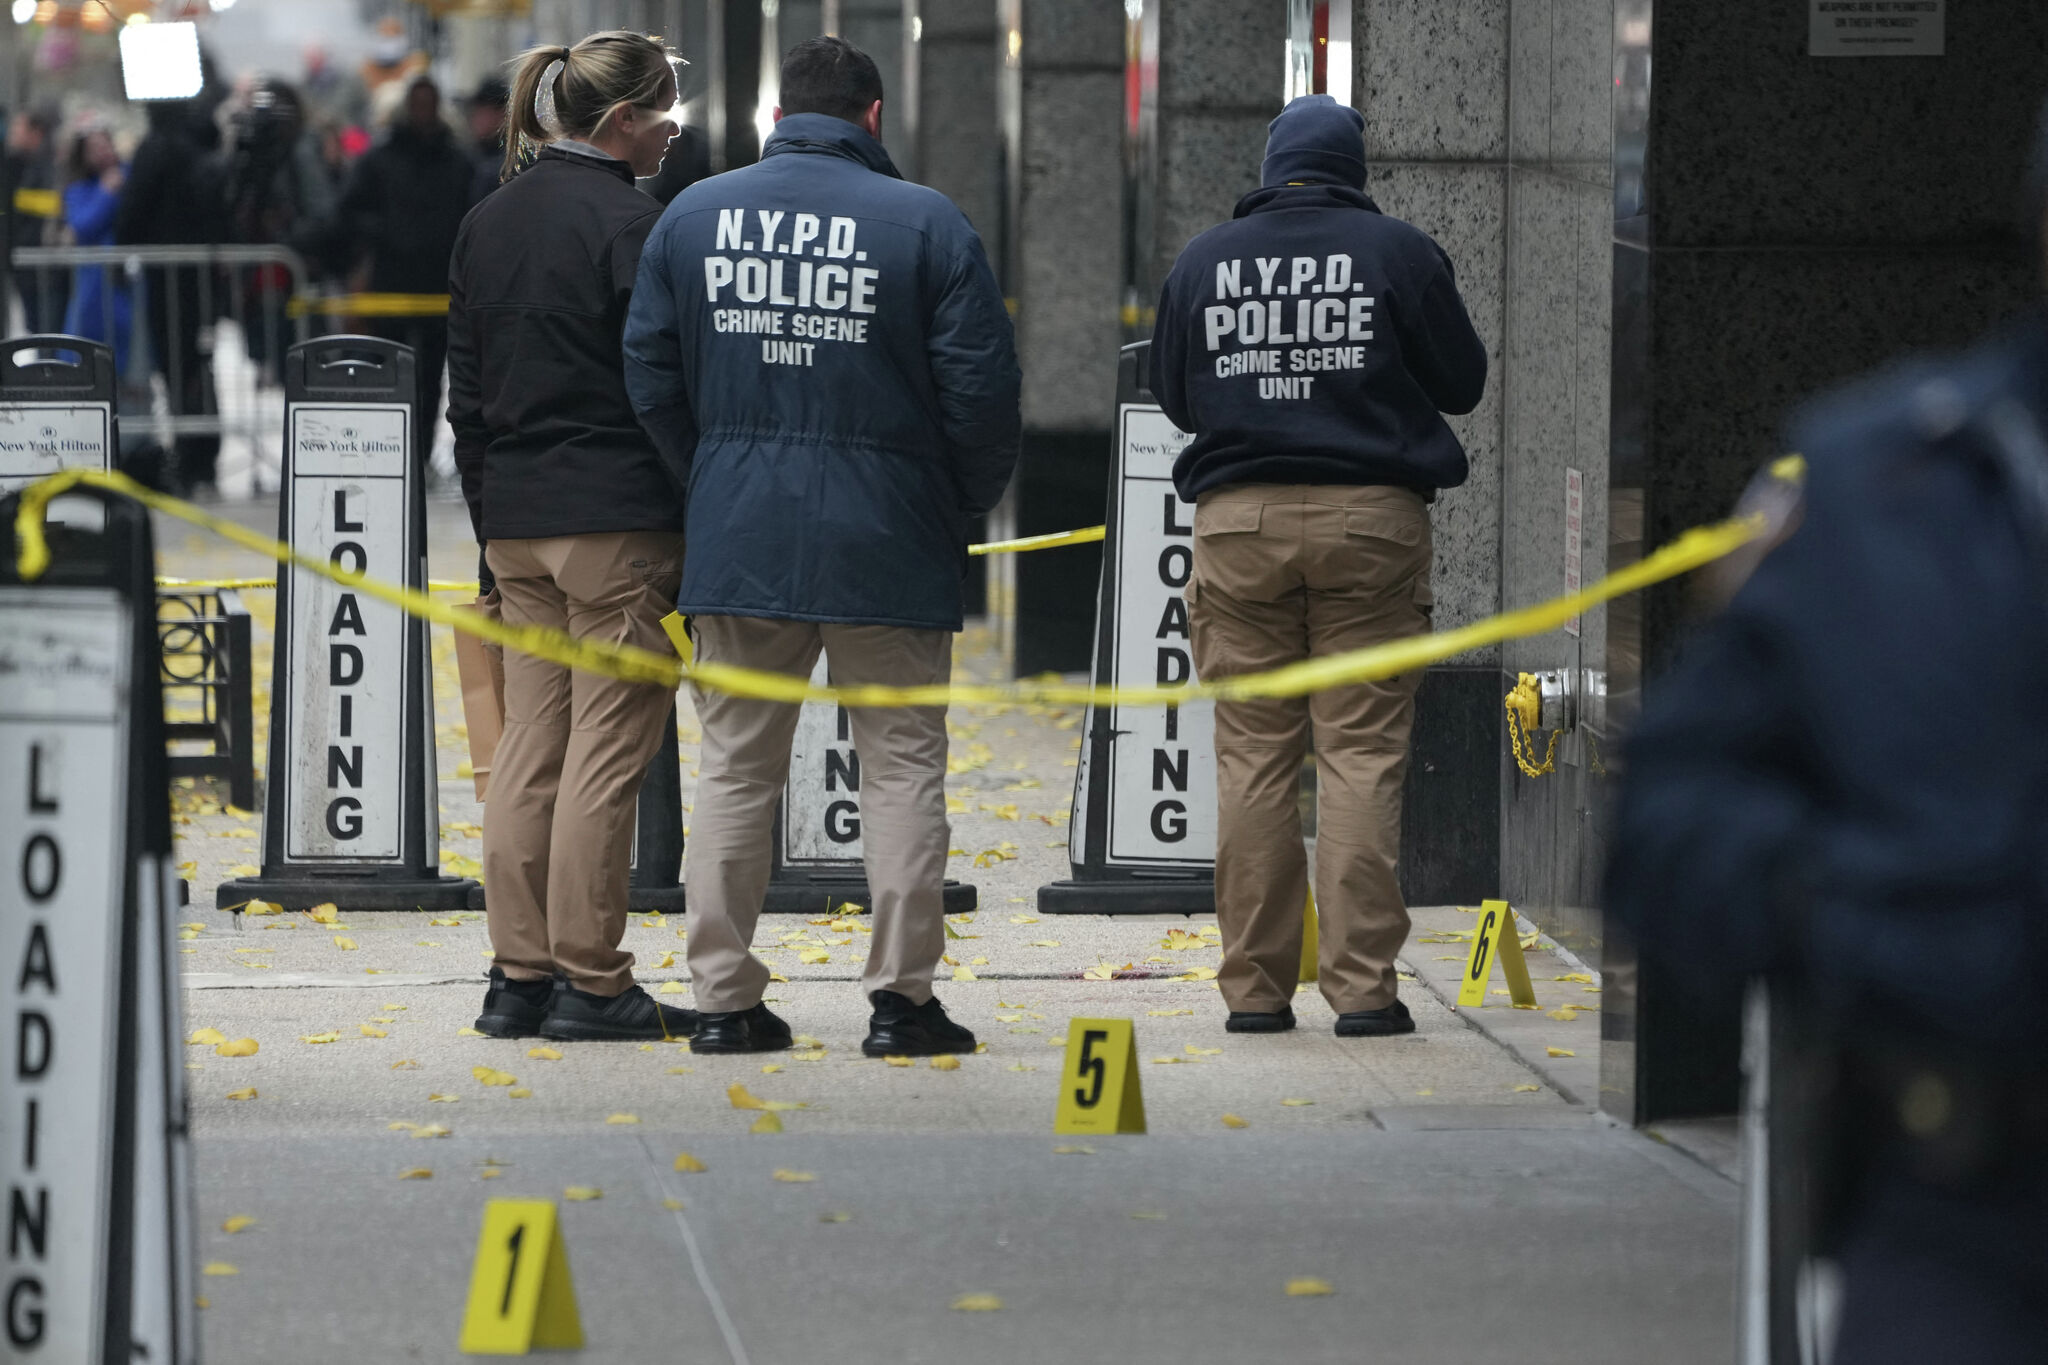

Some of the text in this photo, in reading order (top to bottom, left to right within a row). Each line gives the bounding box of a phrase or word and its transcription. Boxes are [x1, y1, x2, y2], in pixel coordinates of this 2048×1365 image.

[716, 208, 868, 262] N.Y.P.D.
[705, 256, 880, 314] POLICE
[1216, 253, 1364, 300] N.Y.P.D.
[713, 309, 869, 343] CRIME SCENE
[1204, 297, 1375, 351] POLICE
[762, 340, 815, 367] UNIT
[1215, 346, 1366, 379] CRIME SCENE
[1259, 377, 1315, 400] UNIT
[0, 440, 101, 452] New York Hilton
[300, 440, 400, 453] New York Hilton
[1130, 443, 1157, 455] New
[326, 490, 368, 841] LOADING
[1472, 911, 1496, 981] 6
[6, 742, 64, 1353] LOADING
[1075, 1029, 1108, 1110] 5
[499, 1224, 526, 1319] 1
